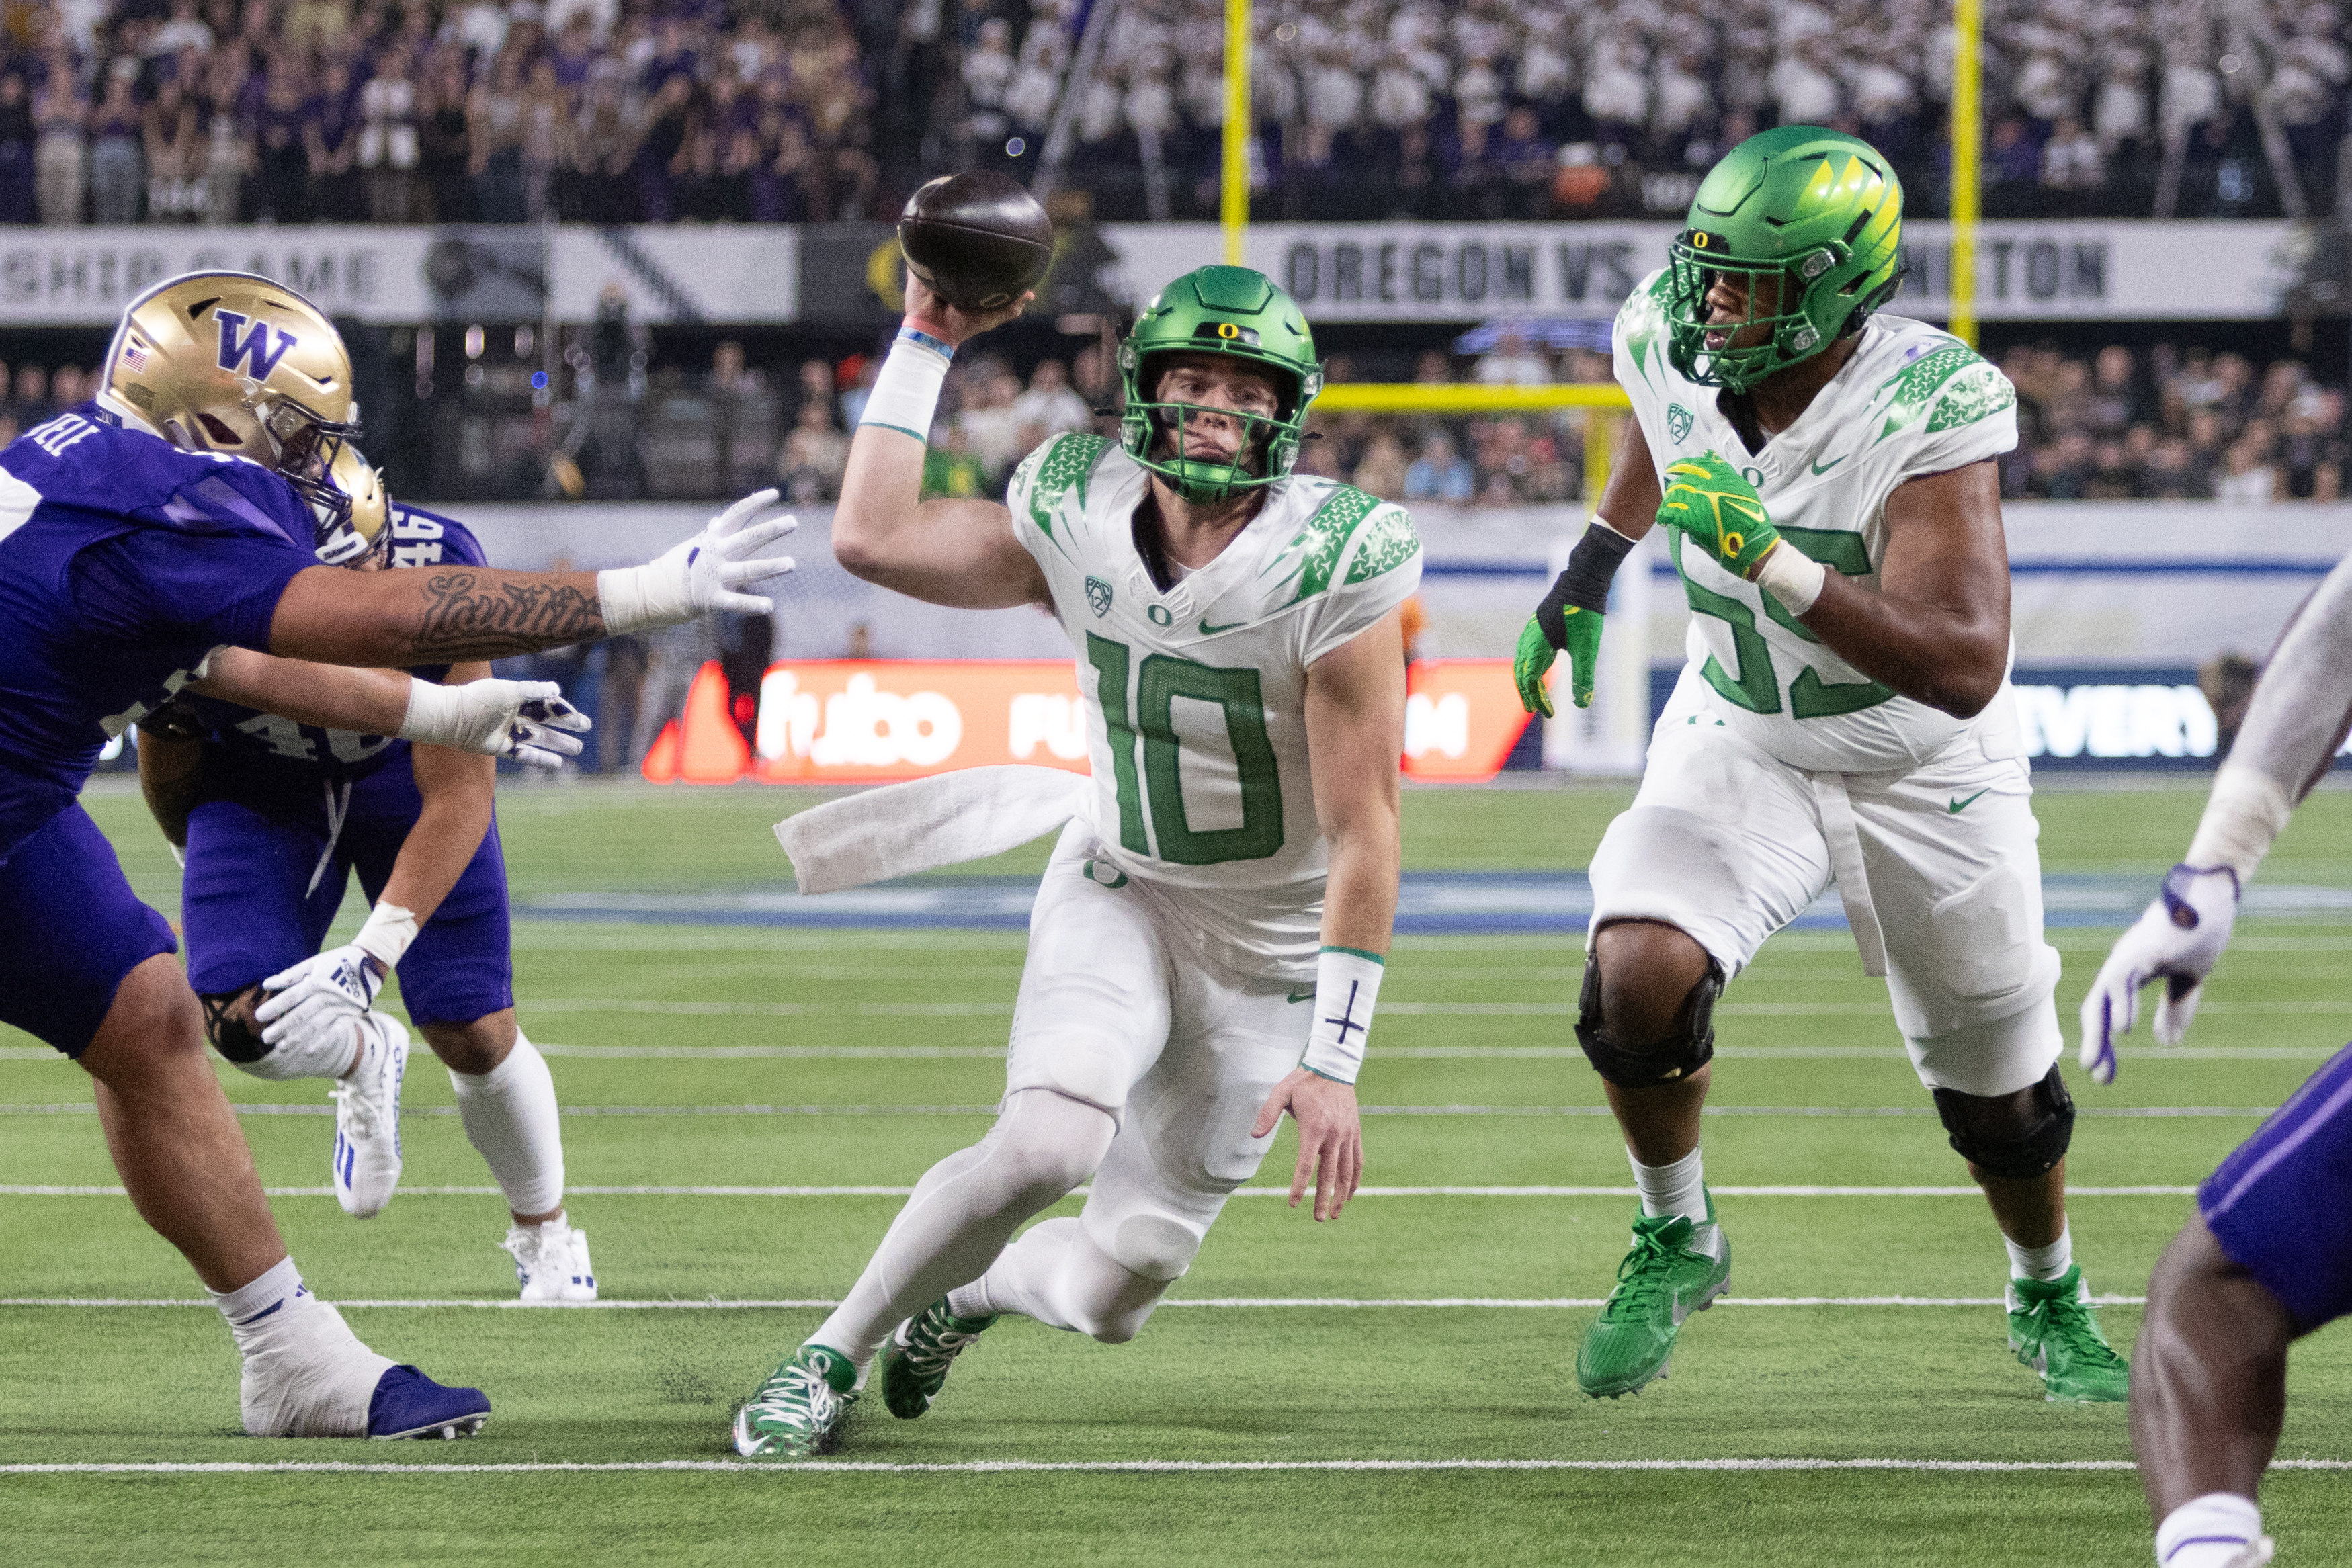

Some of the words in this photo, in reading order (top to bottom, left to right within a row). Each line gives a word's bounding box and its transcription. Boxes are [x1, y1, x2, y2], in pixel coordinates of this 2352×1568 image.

[1286, 241, 1537, 302] OREGON
[1558, 241, 1636, 301] VS
[212, 307, 298, 384] W
[1218, 323, 1238, 339] O
[1086, 578, 1111, 605] PAC
[1091, 595, 1103, 611] 12
[1086, 629, 1284, 865] 10
